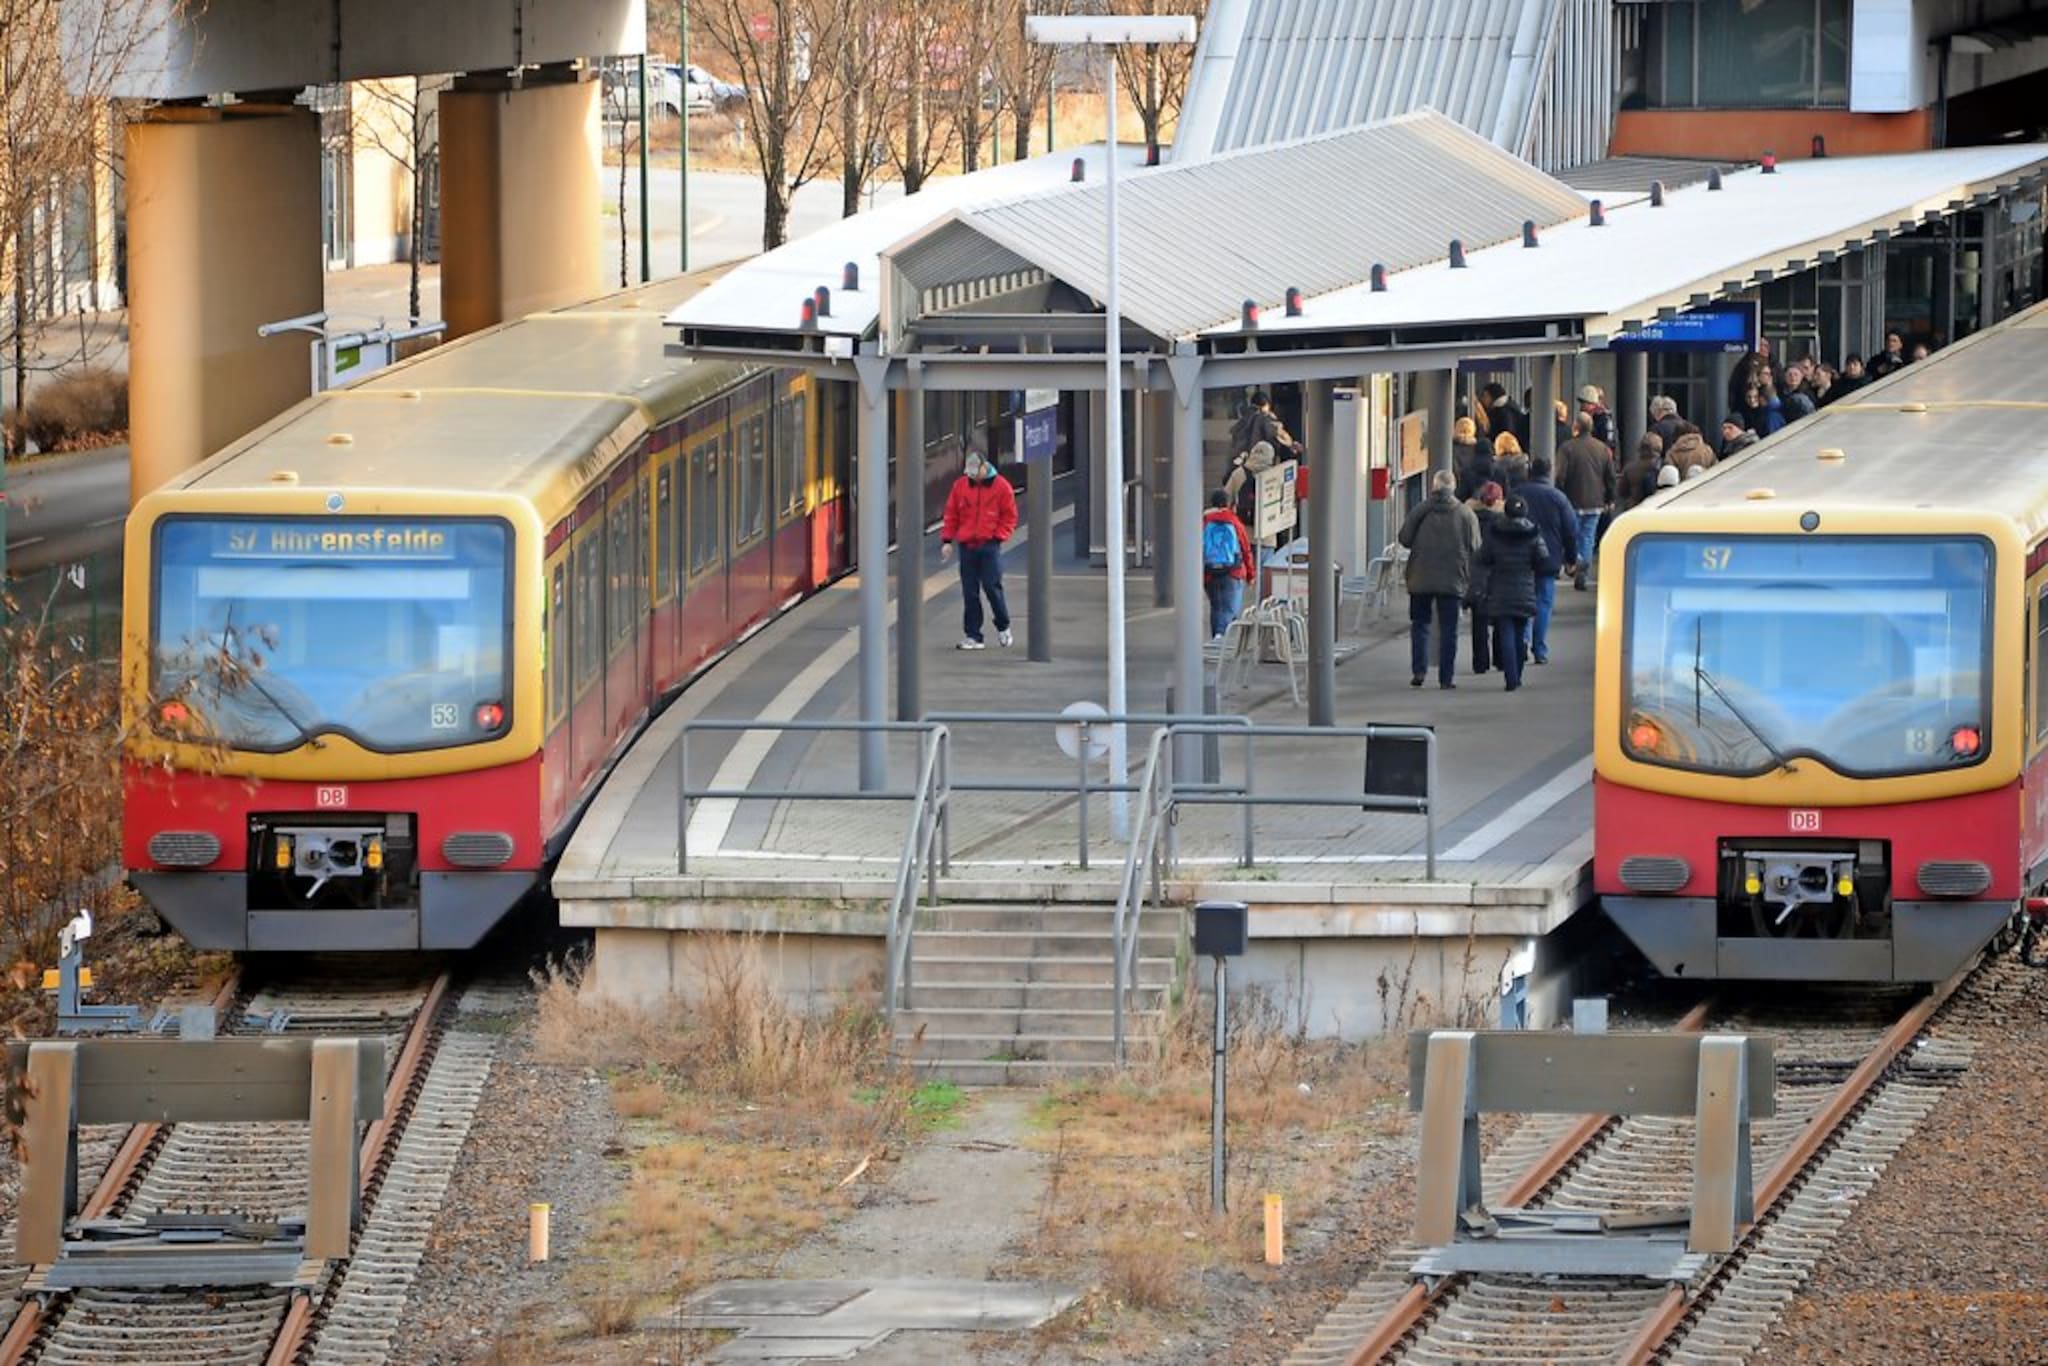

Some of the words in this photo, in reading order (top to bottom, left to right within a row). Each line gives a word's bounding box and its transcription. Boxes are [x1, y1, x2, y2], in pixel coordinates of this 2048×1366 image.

[230, 529, 257, 552] S7
[271, 528, 445, 552] Ahrensfelde
[1701, 545, 1732, 571] S7
[433, 704, 457, 725] 53
[1913, 728, 1928, 752] 8
[319, 788, 344, 805] DB
[1793, 812, 1817, 828] DB
